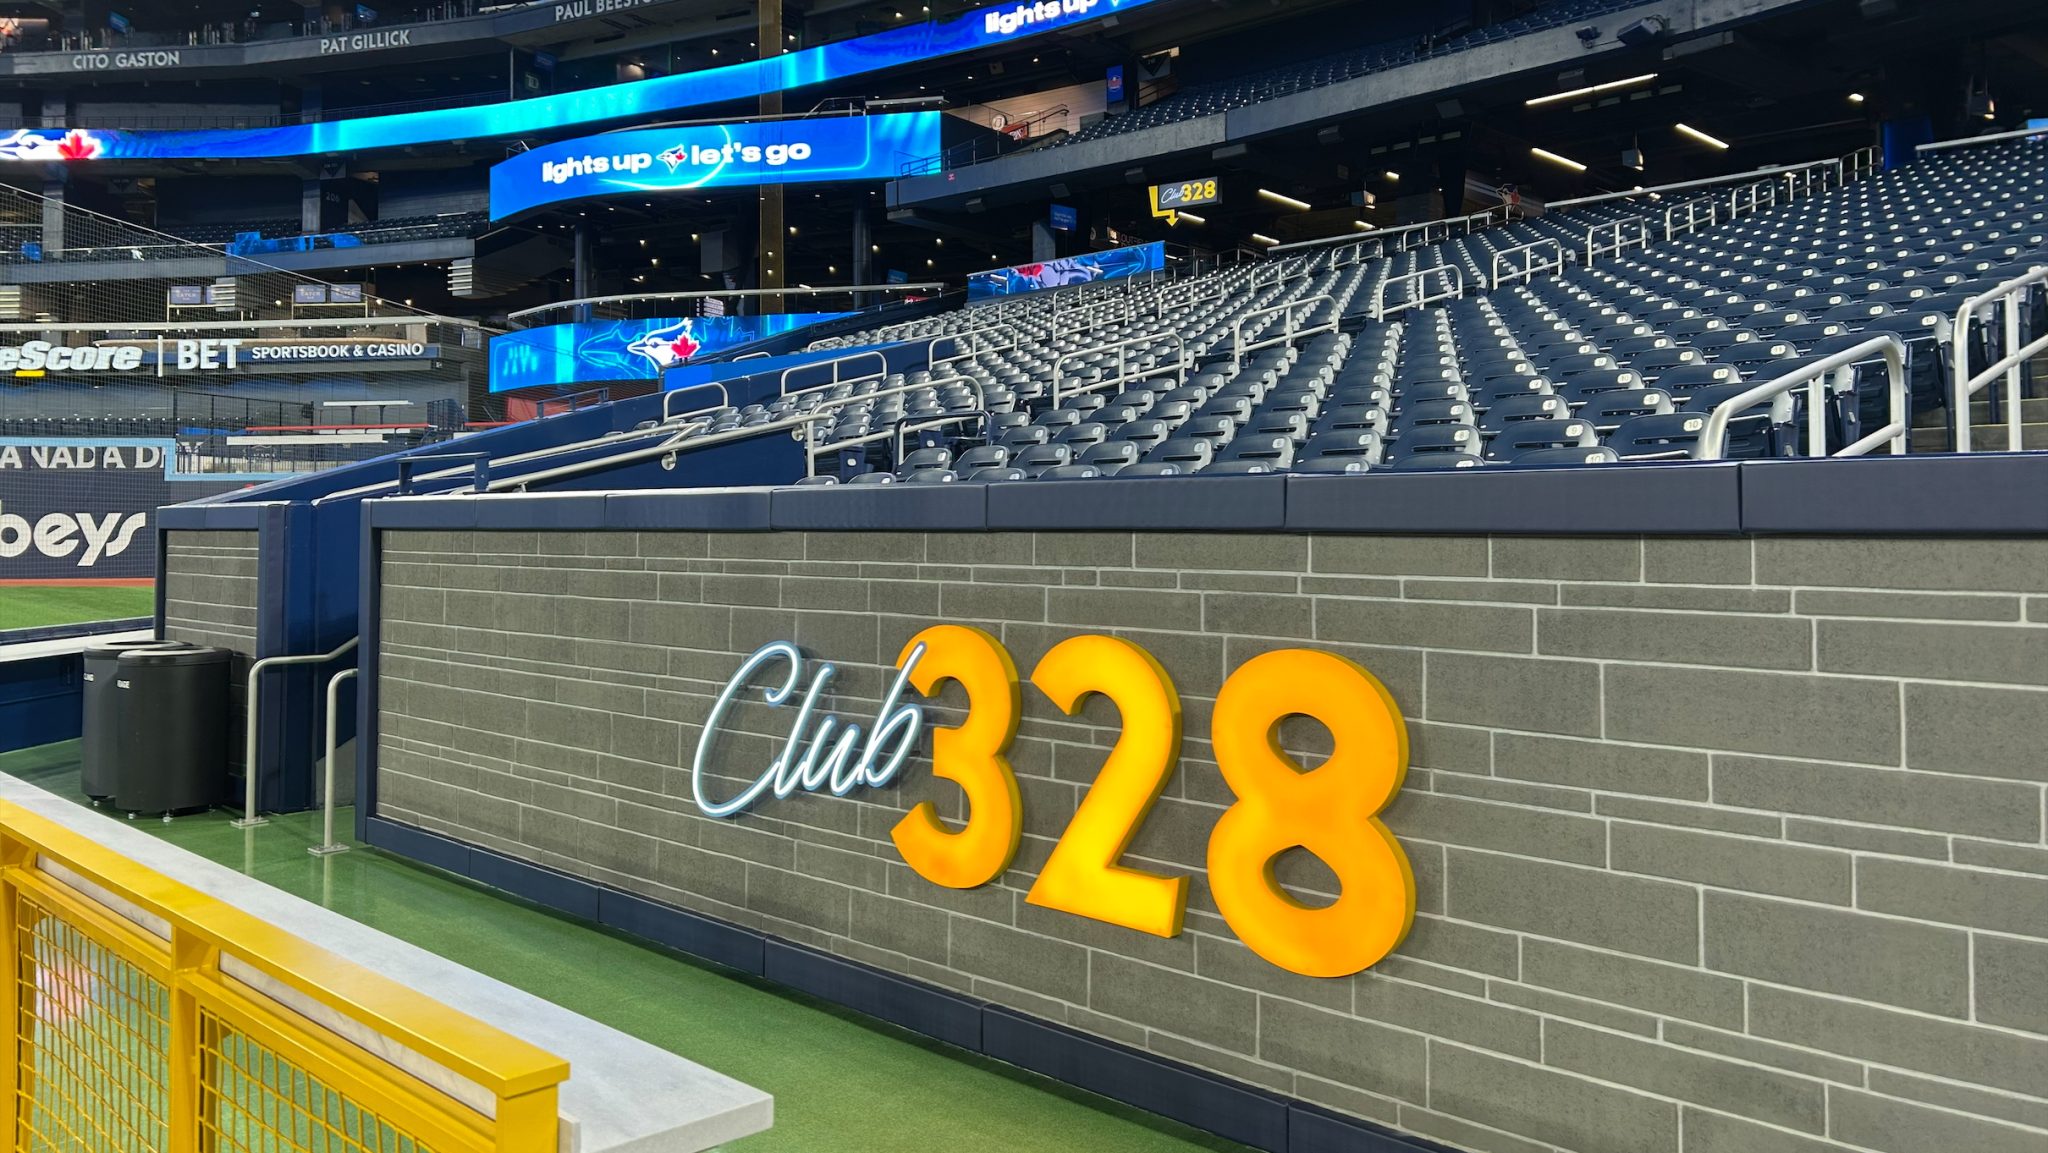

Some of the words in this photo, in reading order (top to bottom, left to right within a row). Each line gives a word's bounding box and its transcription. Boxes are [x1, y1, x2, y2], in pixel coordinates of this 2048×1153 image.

[555, 0, 592, 21] PAUL
[985, 0, 1061, 34] lights
[320, 37, 348, 54] PAT
[351, 29, 410, 50] GILLICK
[72, 54, 109, 69] CITO
[115, 51, 181, 68] GASTON
[542, 153, 610, 183] lights
[612, 152, 652, 174] up
[691, 142, 762, 166] let's
[764, 142, 812, 165] go
[1160, 186, 1185, 204] Club
[1181, 180, 1216, 202] 328
[177, 338, 243, 370] BET
[251, 345, 350, 360] SPORTSBOOK
[352, 345, 364, 358] &
[366, 342, 424, 358] CASINO
[691, 639, 929, 820] Club
[889, 624, 1417, 979] 328
